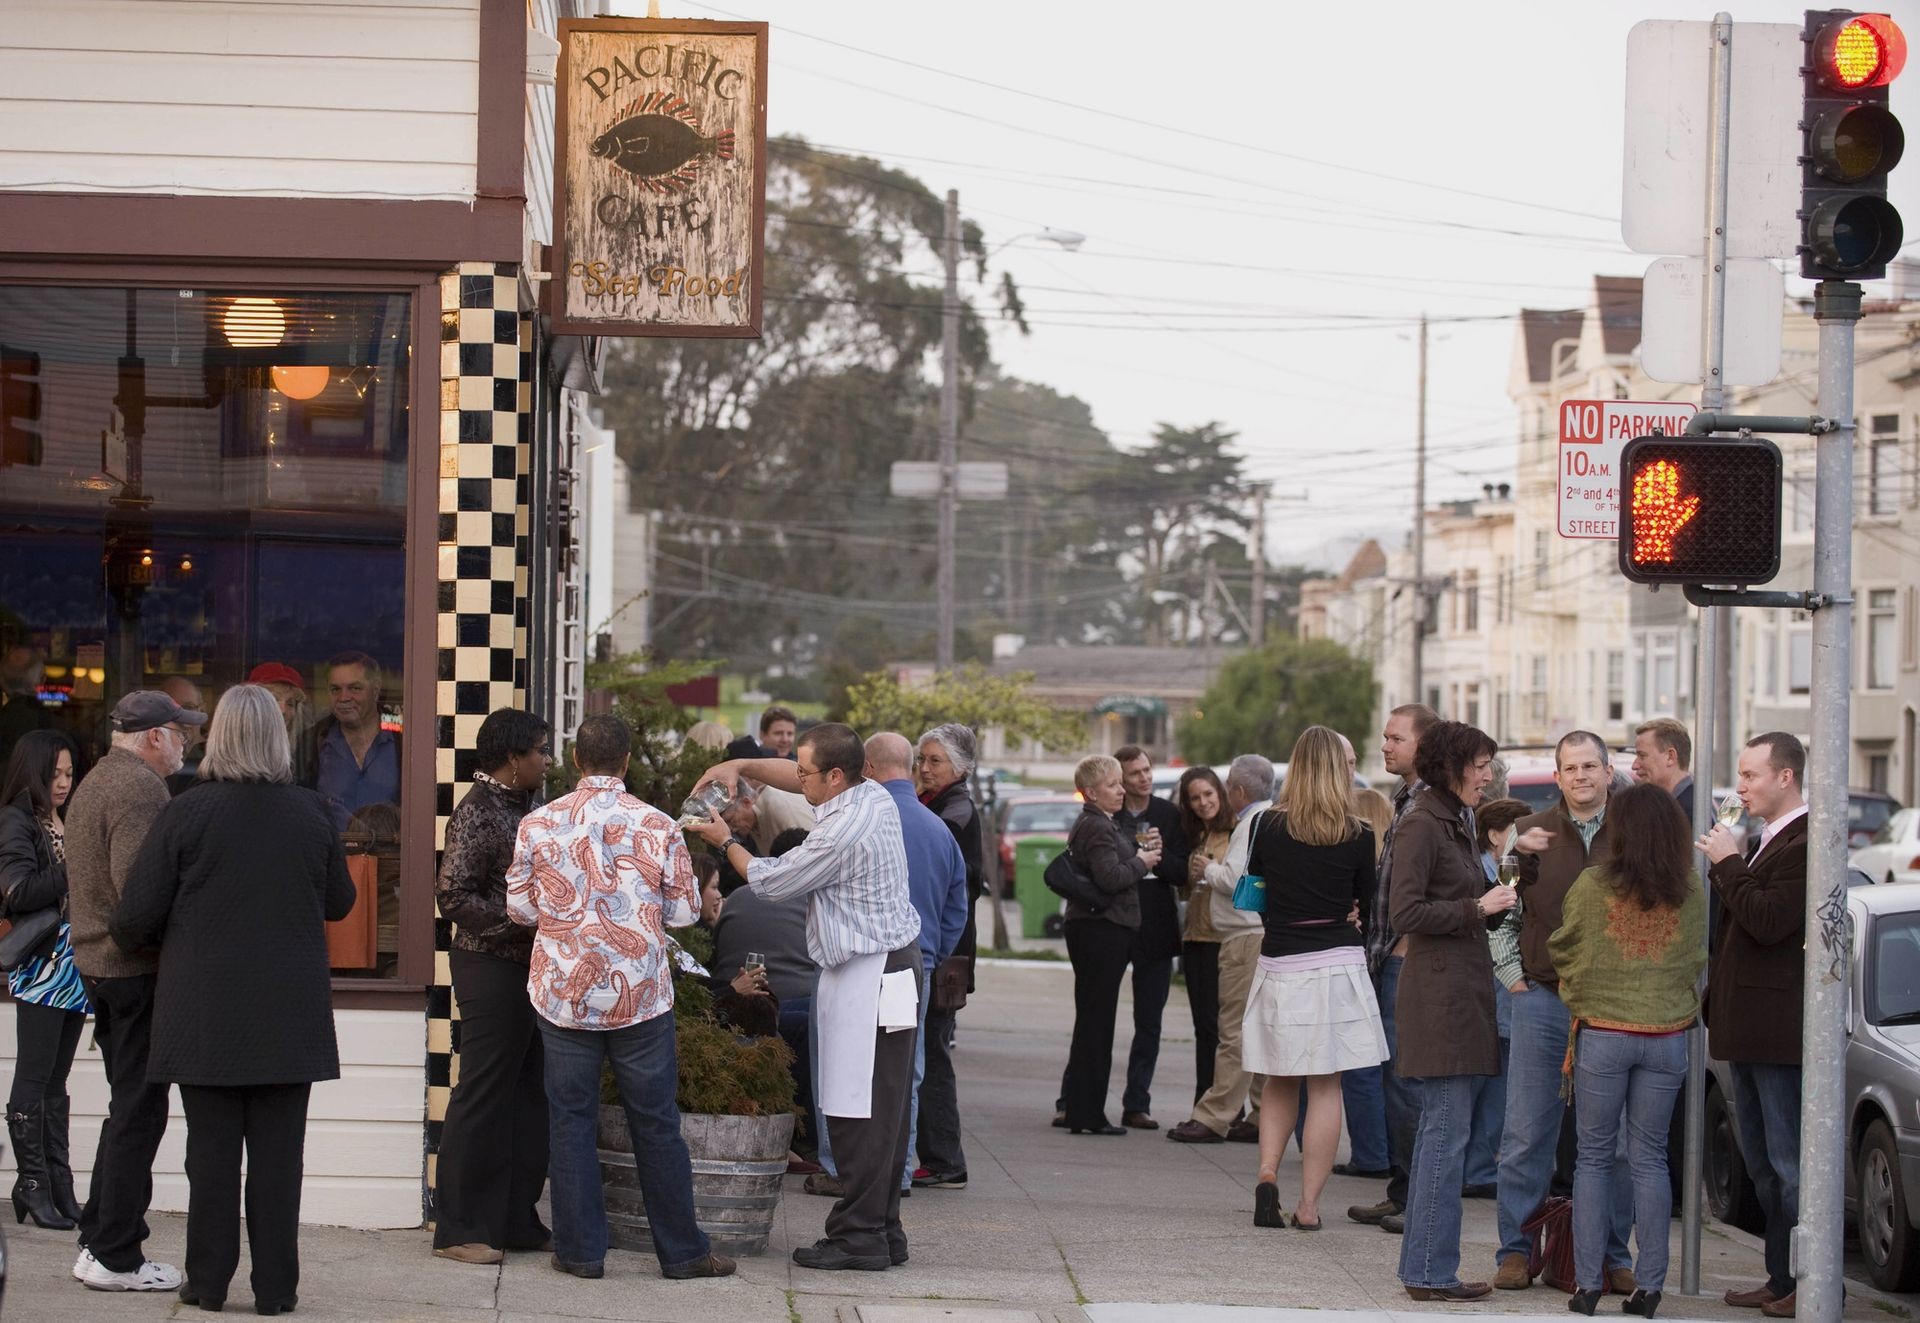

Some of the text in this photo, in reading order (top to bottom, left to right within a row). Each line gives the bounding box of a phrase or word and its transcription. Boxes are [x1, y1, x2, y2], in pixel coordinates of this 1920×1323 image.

[583, 44, 742, 102] PACIFIC
[597, 194, 711, 241] CAFE
[569, 261, 743, 297] Sea Food
[1565, 404, 1600, 439] NO
[1566, 486, 1581, 499] 2nd
[1583, 488, 1602, 500] and
[1595, 503, 1621, 511] OF TH
[1569, 520, 1616, 534] STREET
